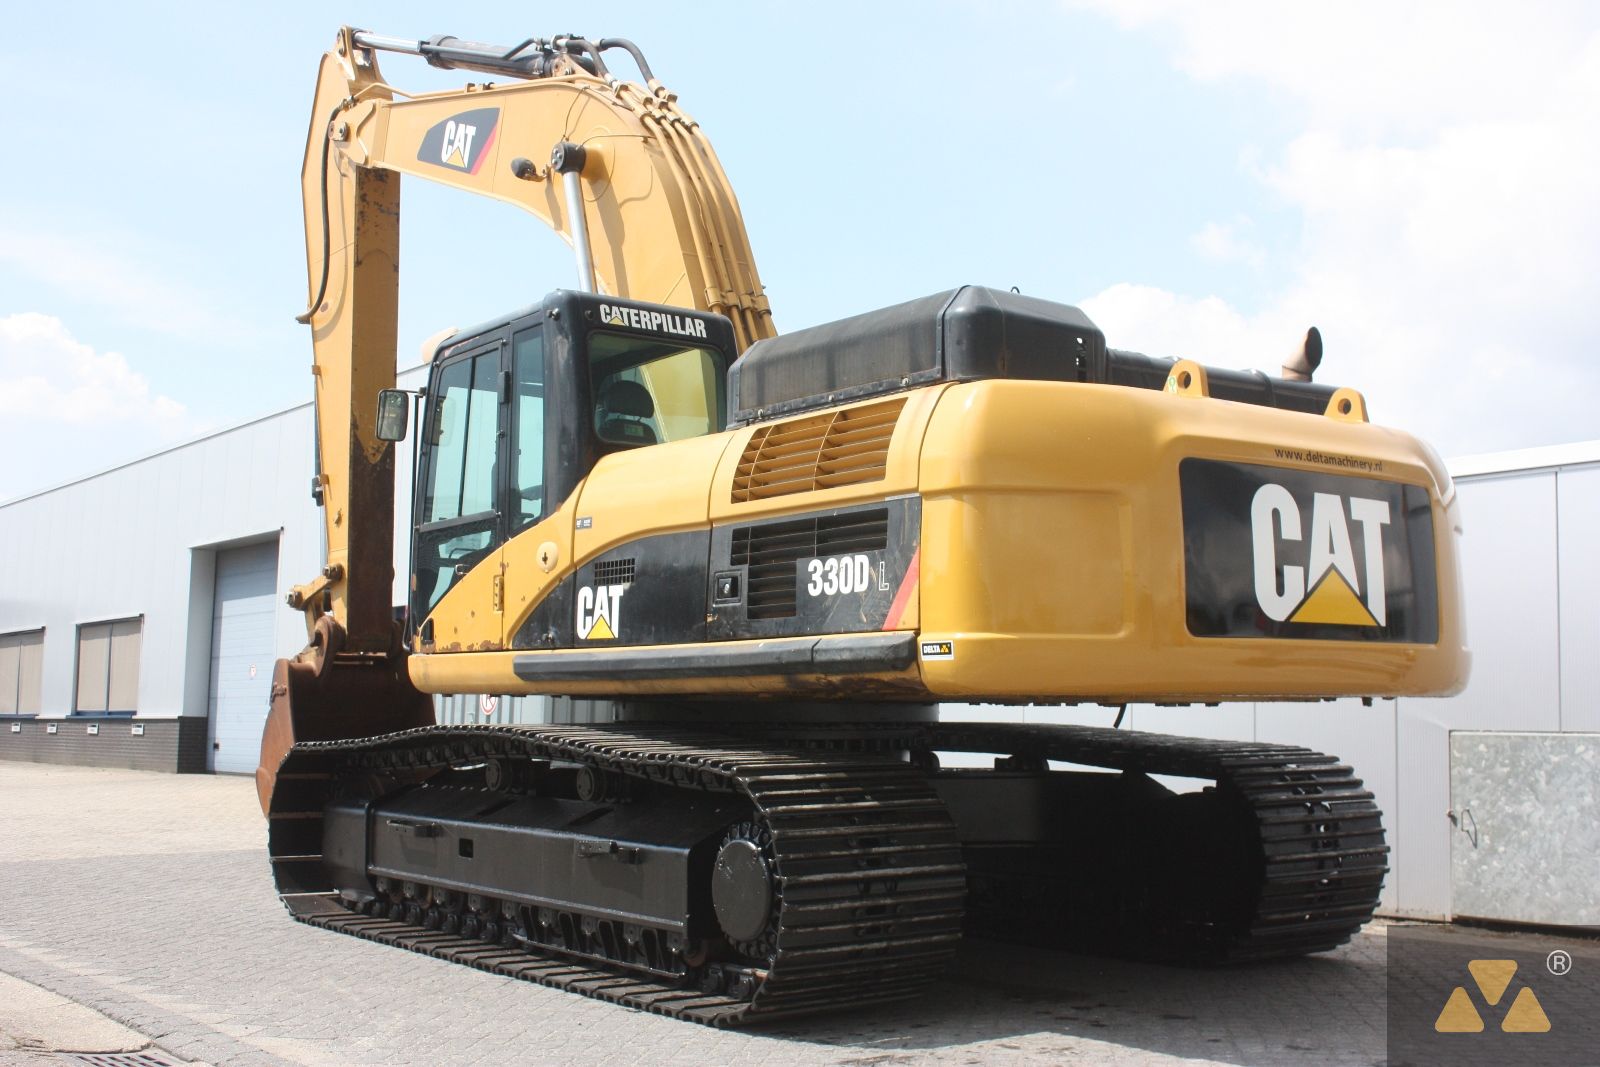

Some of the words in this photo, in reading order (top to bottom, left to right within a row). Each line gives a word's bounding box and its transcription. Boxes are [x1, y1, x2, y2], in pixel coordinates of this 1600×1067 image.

[441, 120, 477, 168] CAT
[599, 304, 707, 338] CATERPILLAR
[1274, 448, 1383, 472] www.deltamachinery.nl
[807, 554, 870, 597] 330D
[878, 561, 890, 591] L
[1250, 483, 1391, 627] CAT
[576, 584, 624, 640] CAT
[923, 645, 941, 654] DELTA
